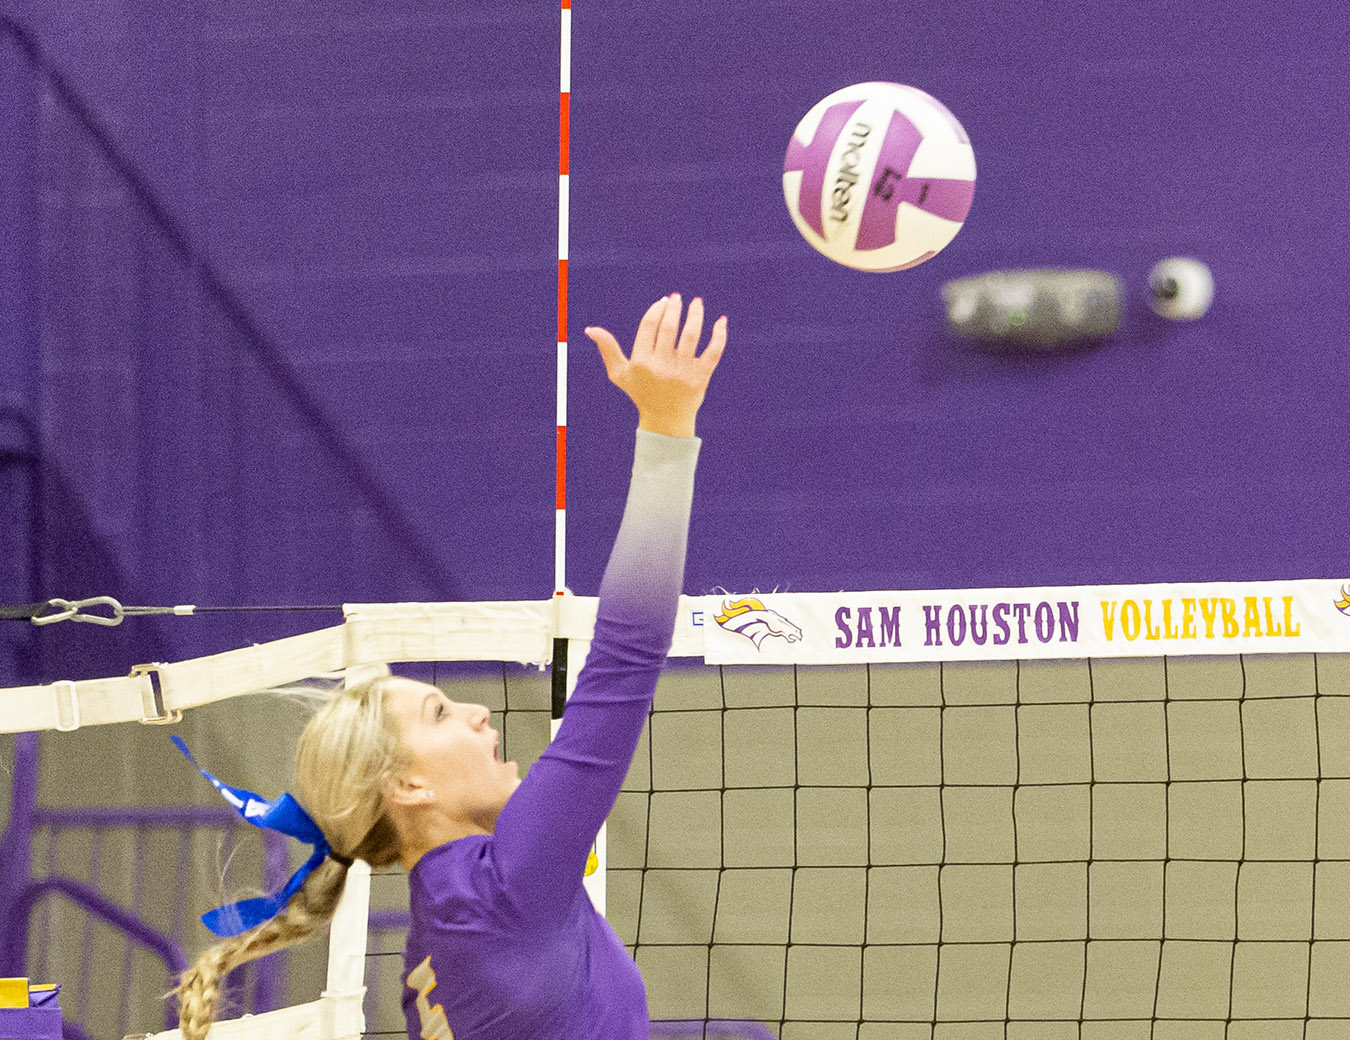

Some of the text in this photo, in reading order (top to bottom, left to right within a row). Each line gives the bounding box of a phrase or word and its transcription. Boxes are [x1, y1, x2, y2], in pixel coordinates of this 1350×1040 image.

[829, 122, 872, 223] molten
[835, 595, 1301, 649] SAM HOUSTON VOLLEYBALL
